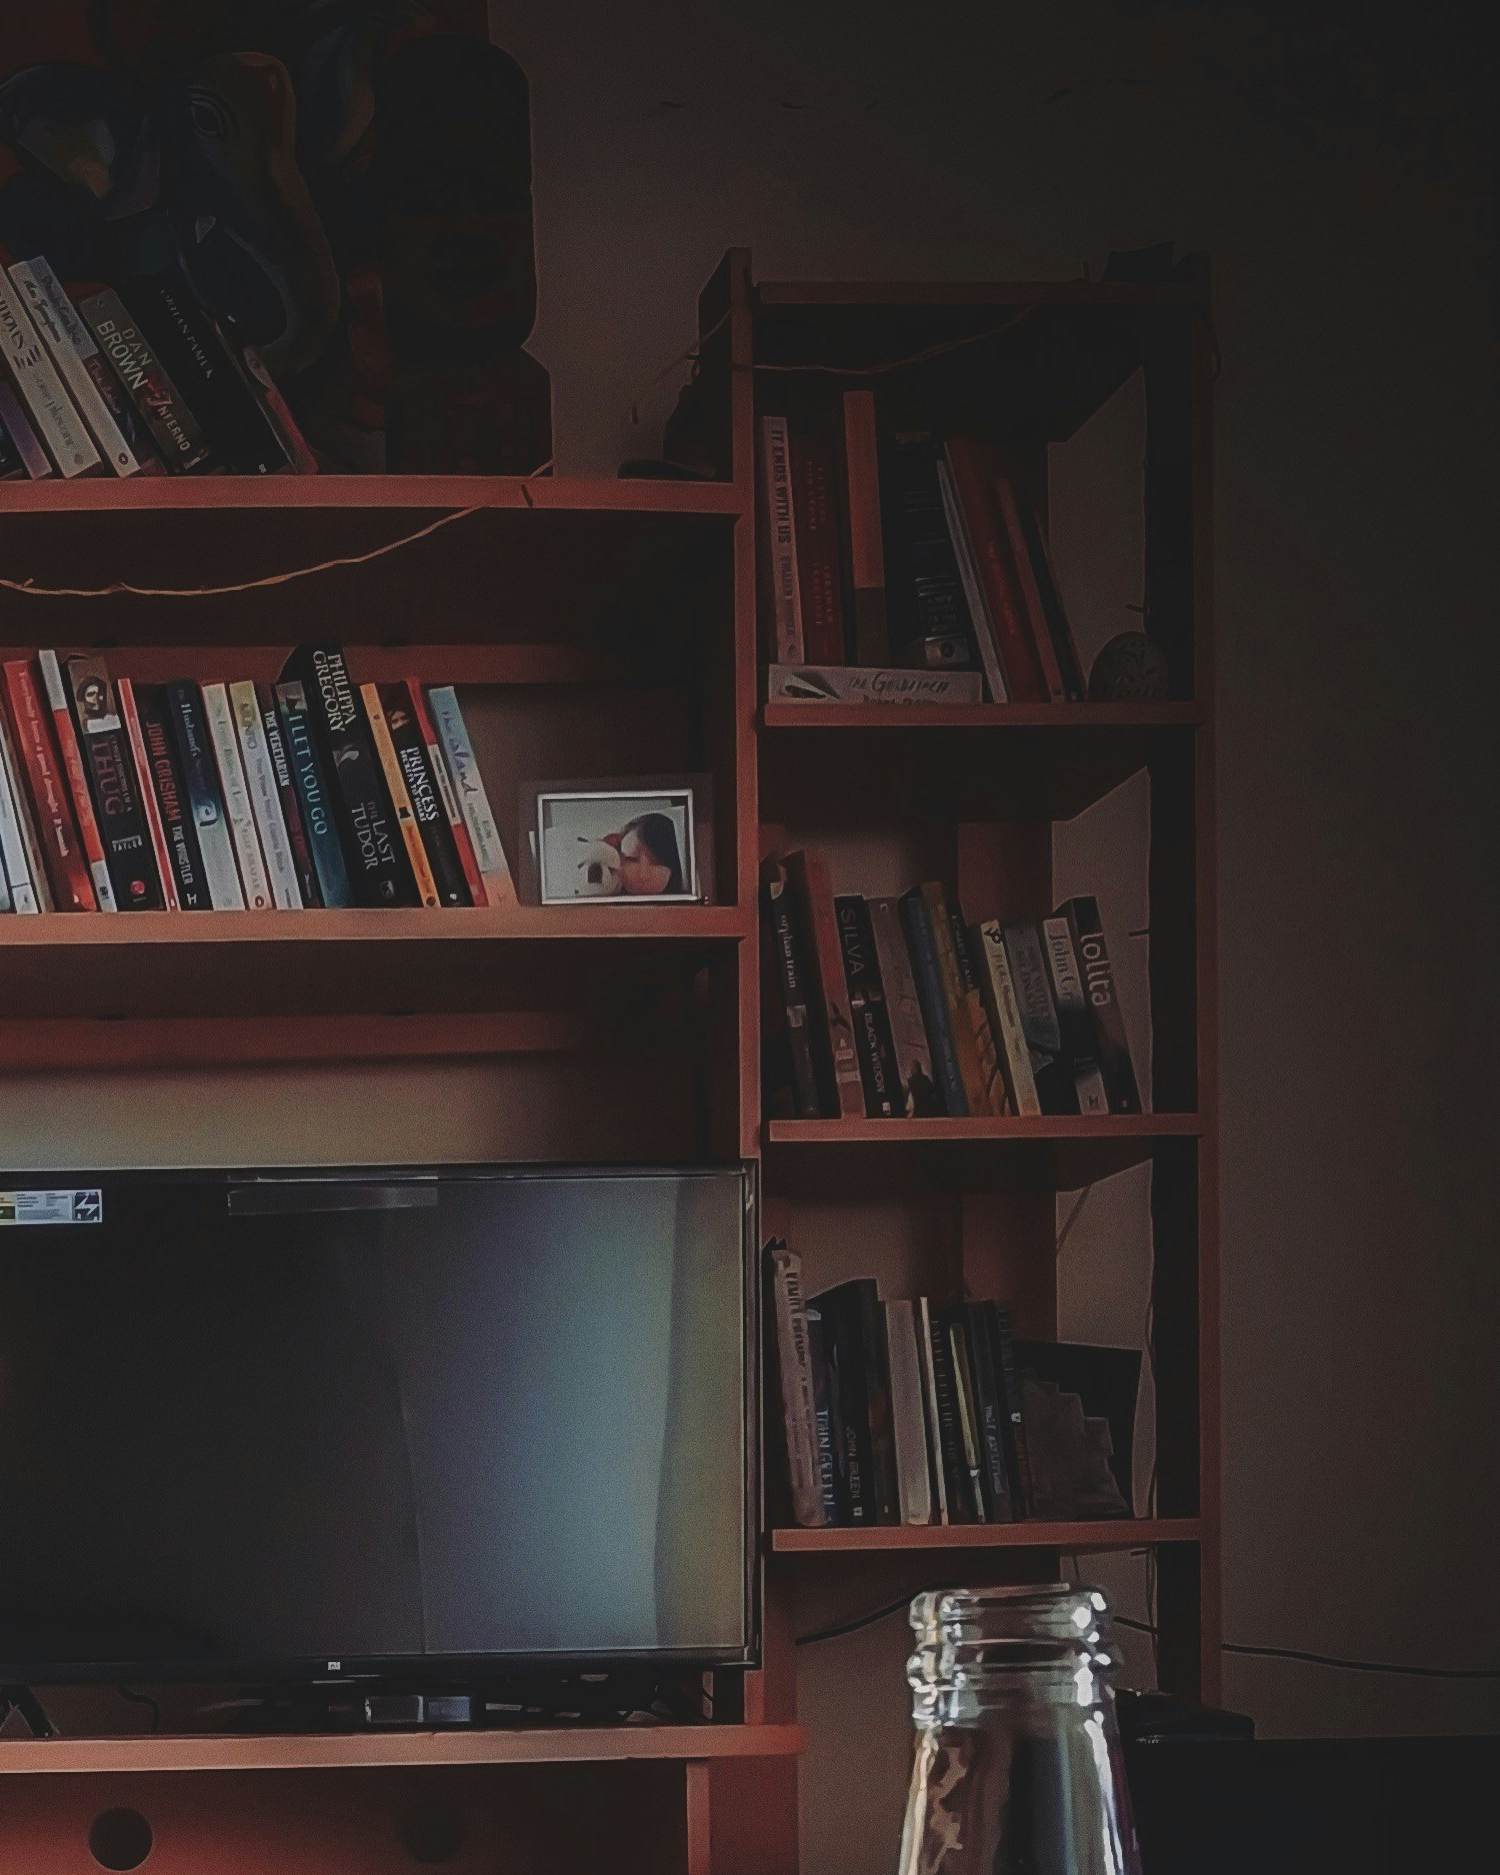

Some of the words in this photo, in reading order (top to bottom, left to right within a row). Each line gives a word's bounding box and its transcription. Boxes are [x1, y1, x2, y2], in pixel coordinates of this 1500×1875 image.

[94, 315, 149, 395] BROWN
[119, 323, 153, 370] DAN
[776, 524, 791, 545] US
[309, 649, 346, 735] GREGORY
[325, 652, 359, 725] PHILIPPA
[145, 719, 168, 758] JOHN
[264, 710, 279, 731] THE
[288, 714, 302, 722] I
[290, 724, 311, 757] LET
[90, 739, 124, 817] THUG
[268, 730, 292, 787] VEGETARIAN
[154, 758, 182, 823] GRISHAM
[299, 762, 322, 805] YOU
[405, 745, 440, 822] PRINCESS
[309, 806, 328, 837] GO
[347, 803, 381, 871] TUDOR
[371, 819, 397, 867] LAST
[775, 914, 795, 958] orphan
[839, 907, 866, 976] SILVA
[784, 959, 801, 989] train
[1081, 932, 1112, 1007] lolita
